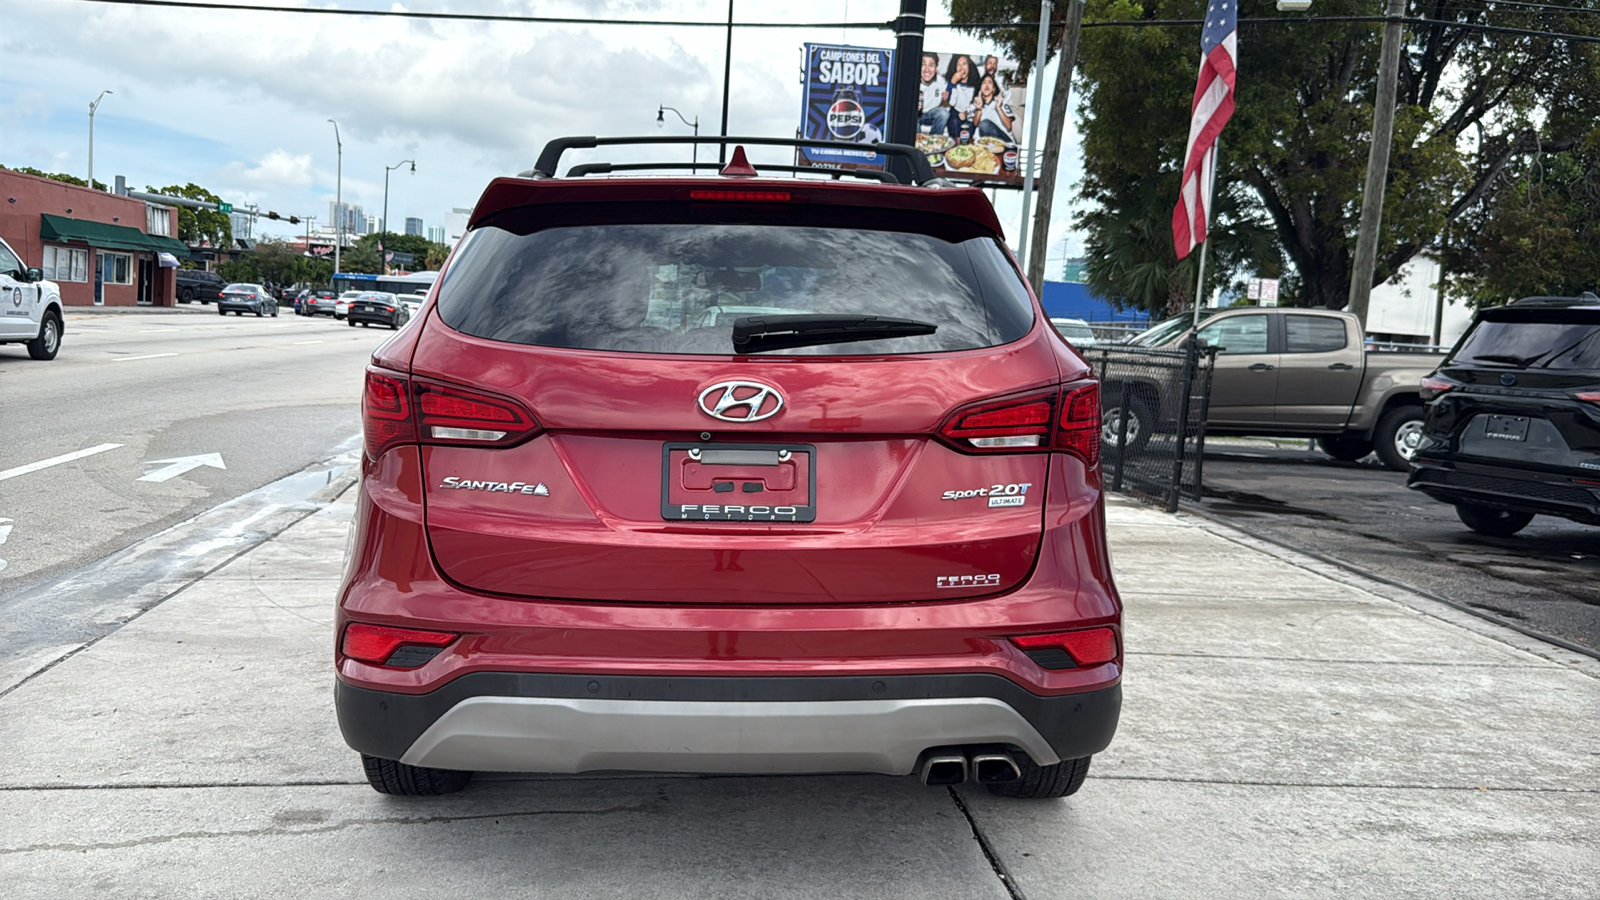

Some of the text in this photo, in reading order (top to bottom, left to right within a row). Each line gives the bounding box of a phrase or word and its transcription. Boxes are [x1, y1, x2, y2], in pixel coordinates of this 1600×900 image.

[820, 50, 880, 63] CAMPEONES DEL
[819, 61, 880, 86] SABOR
[829, 114, 862, 124] PEPSI
[941, 483, 1032, 500] Sport 2.0T
[991, 497, 1022, 505] ULTIMATE
[681, 504, 797, 515] FERCO
[681, 513, 796, 521] MOTORS
[937, 574, 1000, 582] FERCO
